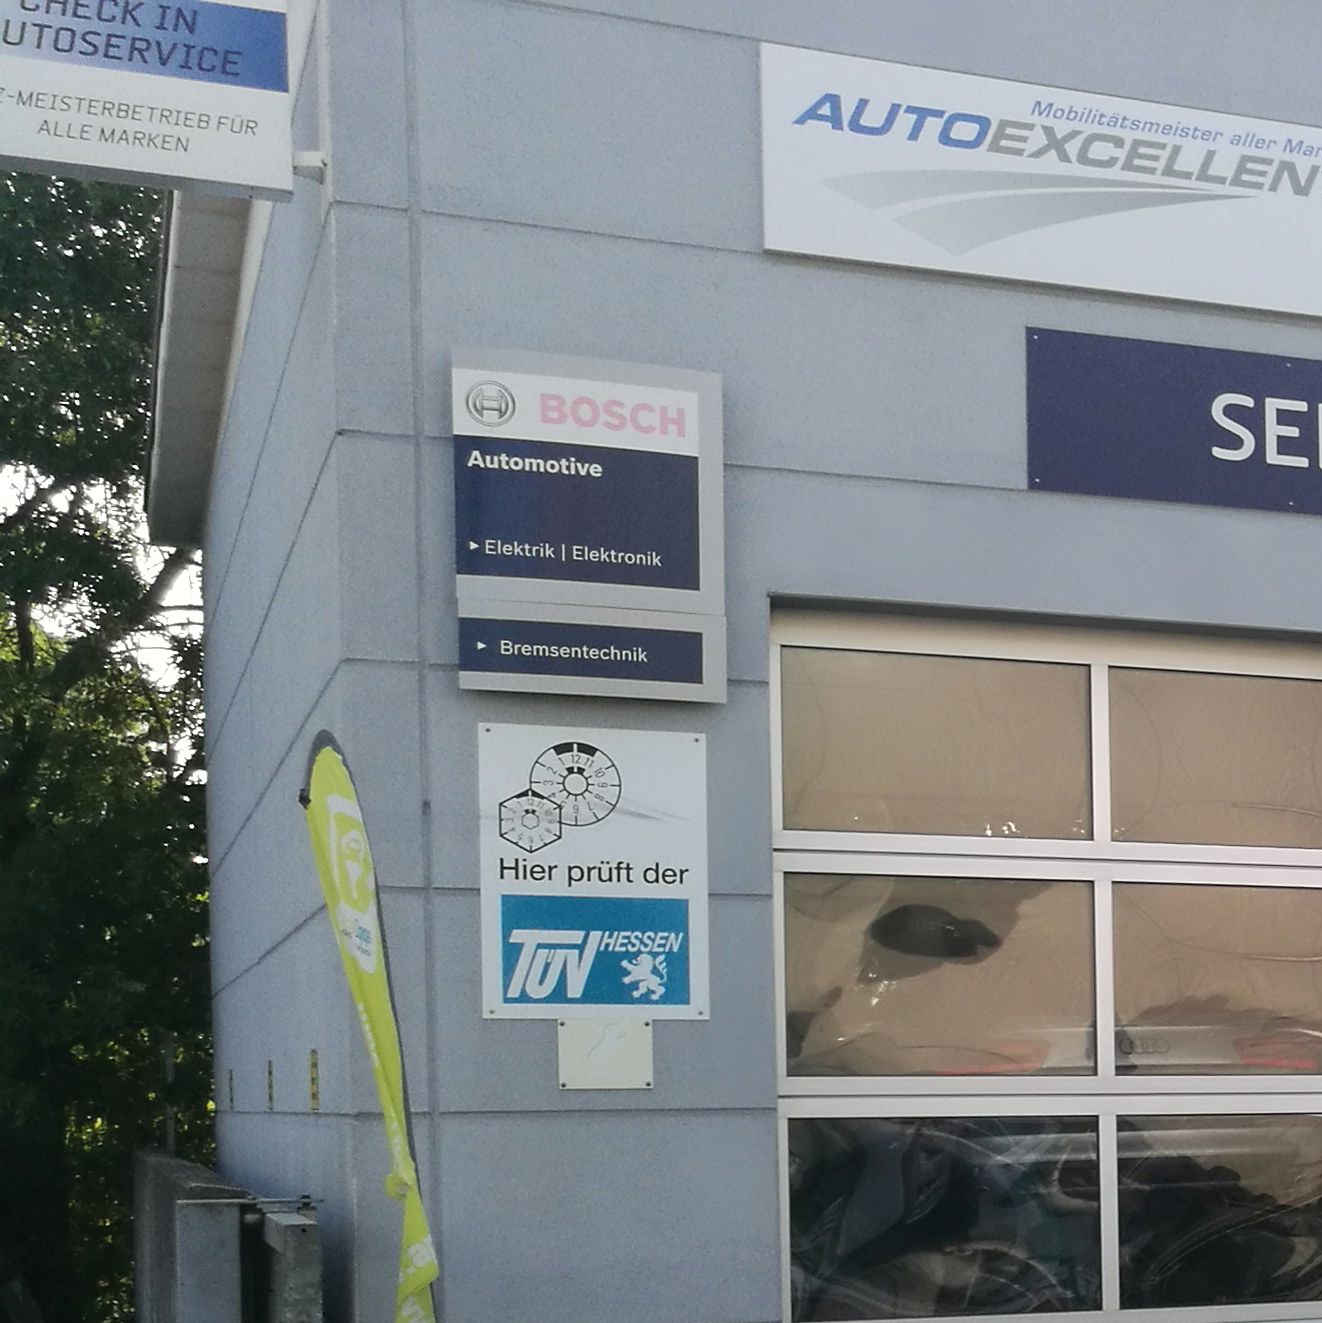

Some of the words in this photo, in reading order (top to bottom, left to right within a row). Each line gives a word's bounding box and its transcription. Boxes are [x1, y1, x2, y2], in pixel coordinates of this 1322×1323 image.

[155, 4, 198, 35] IN
[37, 119, 93, 142] ALLE
[98, 127, 190, 153] MARKEN
[216, 114, 259, 136] FÜR
[1031, 100, 1224, 143] Mobilitätsmeister
[1230, 131, 1277, 152] aller
[538, 392, 686, 438] BOSCH
[467, 450, 603, 478] Automotive
[484, 540, 555, 559] Elektrik
[572, 545, 662, 567] Elektronik
[500, 640, 648, 663] Bremsentechnik
[499, 857, 558, 881] Hier
[567, 861, 634, 887] prüft
[642, 862, 689, 885] der
[601, 931, 684, 953] HESSEN
[506, 929, 602, 998] TÜV
